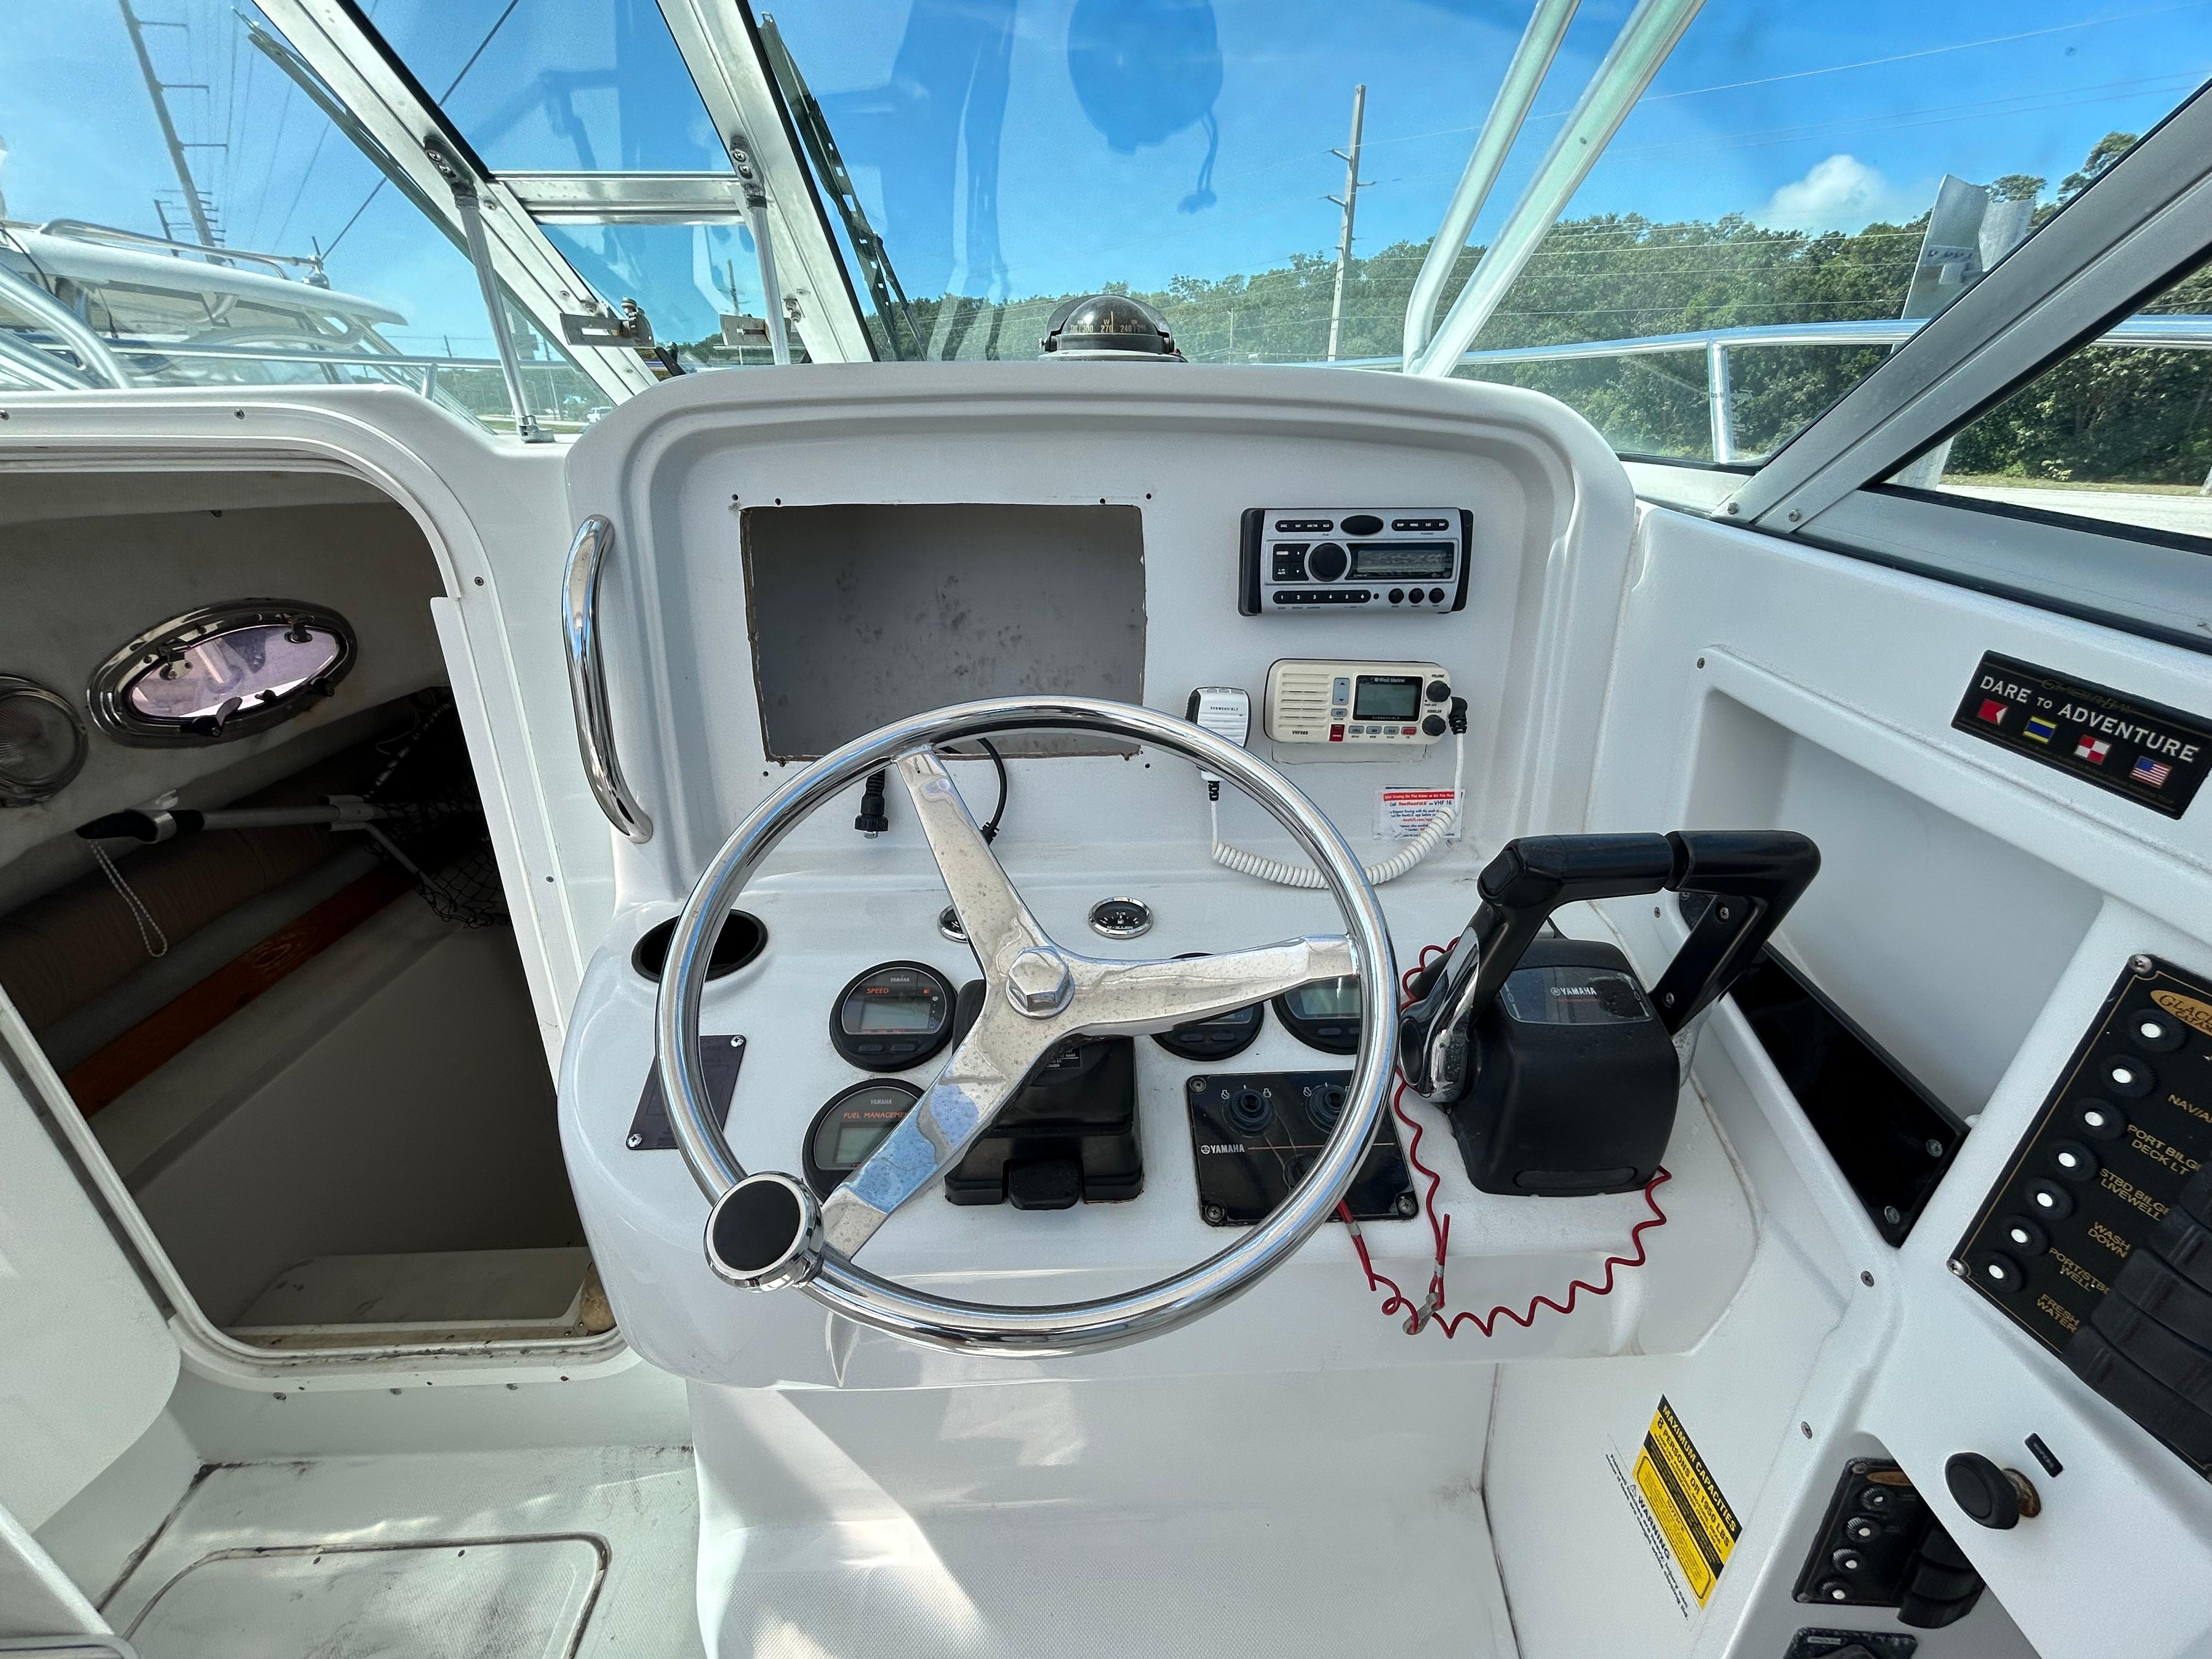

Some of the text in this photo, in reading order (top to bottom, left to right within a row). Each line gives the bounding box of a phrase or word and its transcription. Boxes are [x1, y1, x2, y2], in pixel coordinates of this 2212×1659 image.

[1979, 675, 2032, 704] DARE
[2037, 697, 2053, 709] TO
[2058, 703, 2200, 763] ADVENTURE
[1559, 987, 1598, 995] YAMAHA
[1210, 1144, 1245, 1154] YAMAHA
[2127, 1124, 2166, 1149] PORT
[2131, 1139, 2190, 1175] DECK LT
[2100, 1168, 2134, 1192] STBD
[2101, 1178, 2161, 1222] LIVEWELL
[2087, 1228, 2128, 1259] DOWN
[2094, 1221, 2131, 1250] WASH
[2061, 1264, 2091, 1292] WELL
[2037, 1299, 2077, 1333] WATER
[2041, 1294, 2080, 1326] FRESH
[1658, 1417, 1664, 1430] 8
[1663, 1429, 1691, 1477] PERSONS
[1690, 1477, 1700, 1495] OR
[1700, 1494, 1717, 1523] 1950
[1716, 1522, 1730, 1547] LBS
[1663, 1405, 1696, 1462] MAXIMUM
[1695, 1461, 1736, 1532] CAPACITIES
[1639, 1496, 1669, 1560] WARNING
